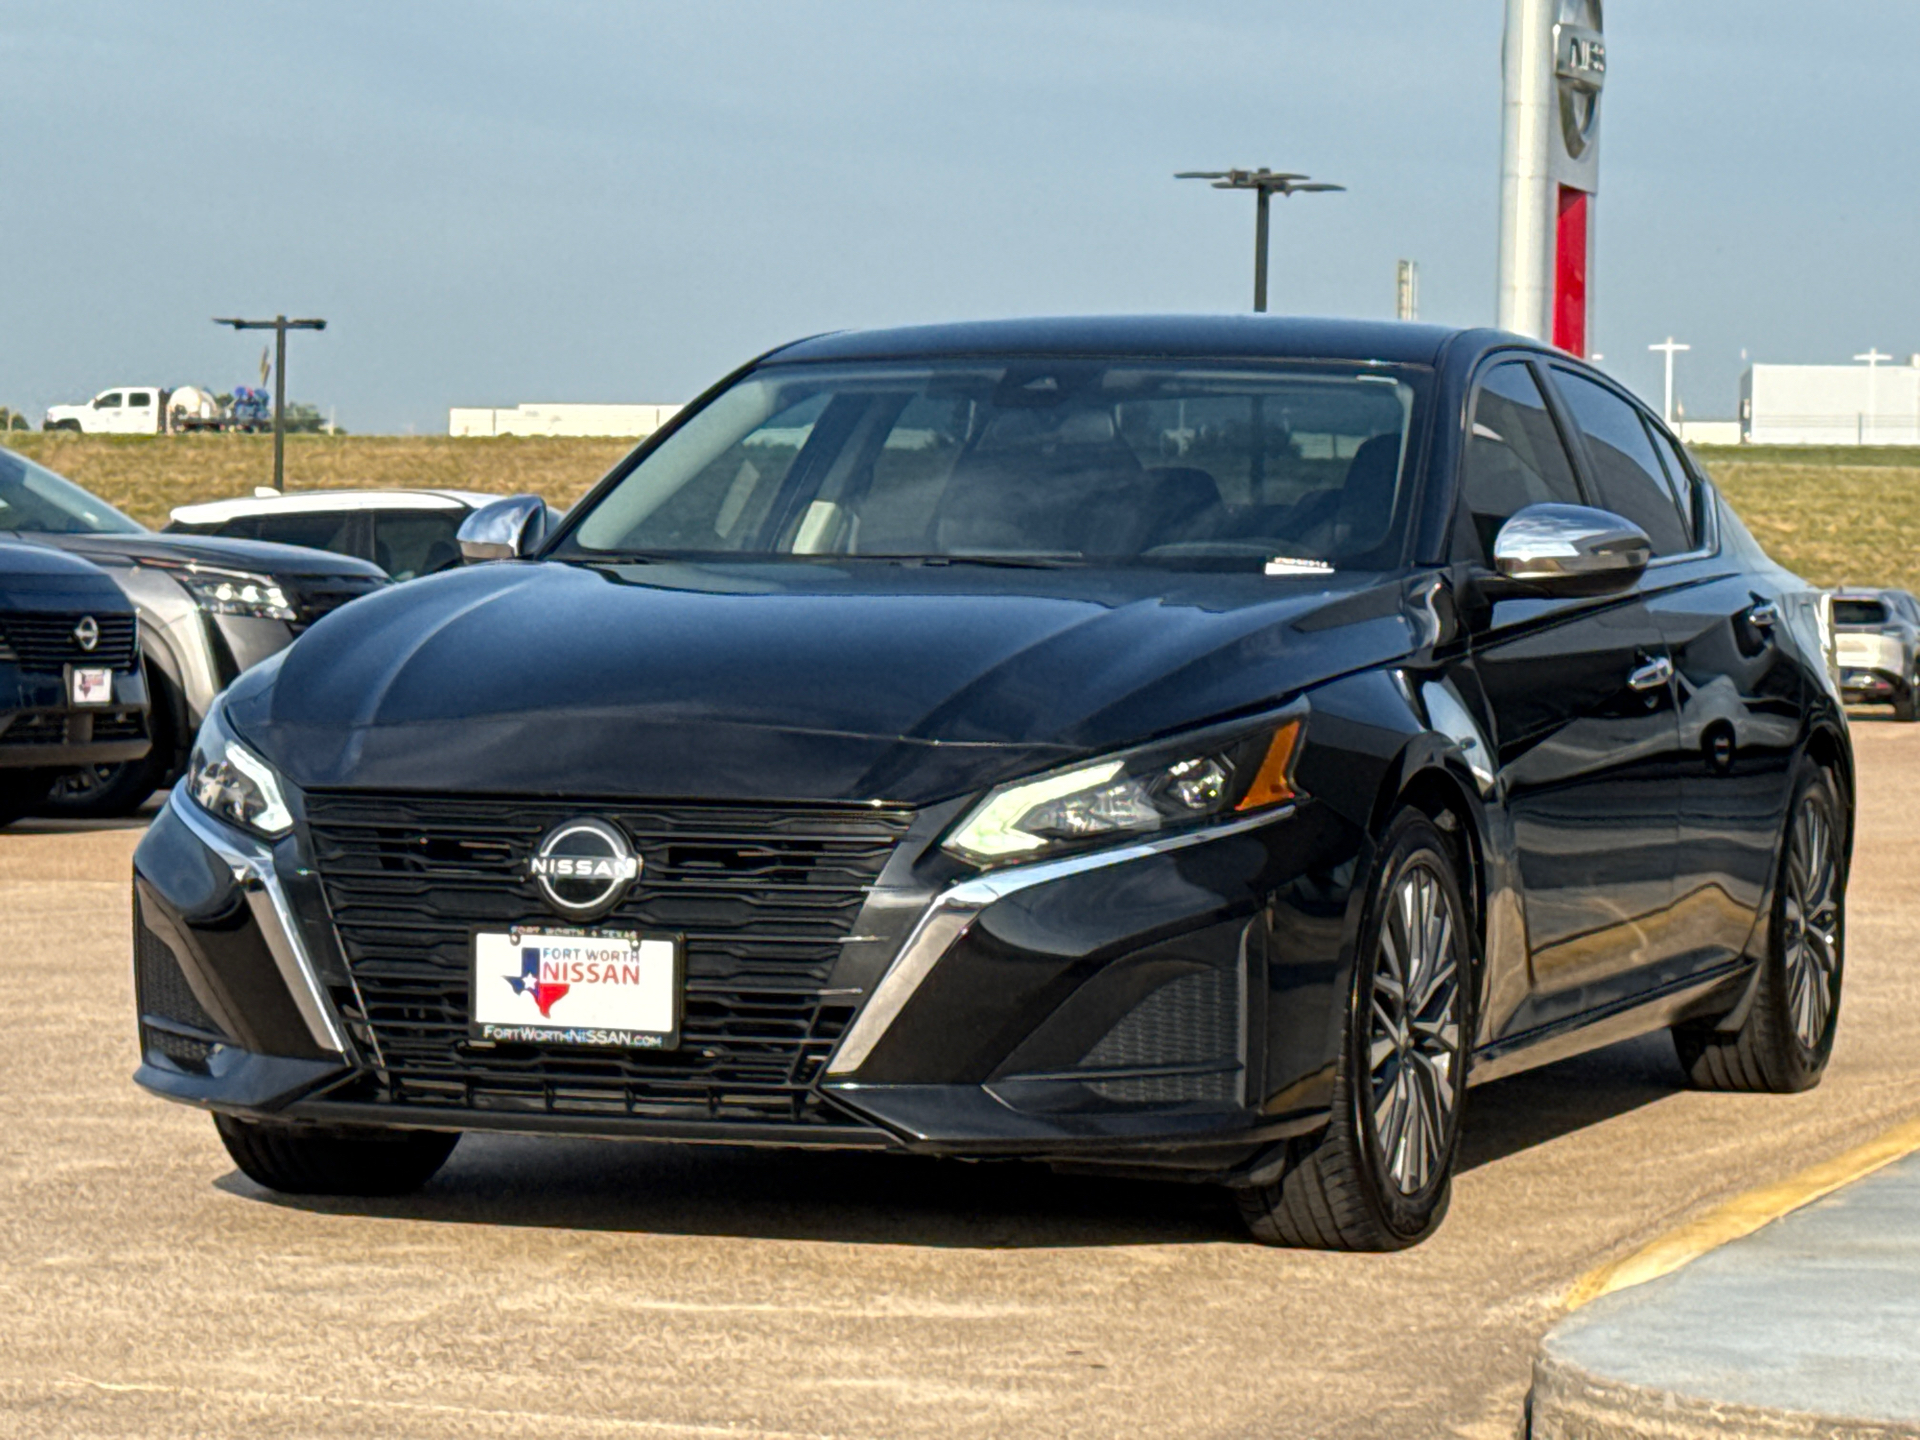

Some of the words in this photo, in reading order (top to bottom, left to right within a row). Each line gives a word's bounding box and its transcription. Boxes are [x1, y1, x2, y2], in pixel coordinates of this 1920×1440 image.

[531, 858, 628, 876] NISSAN
[543, 947, 581, 960] FORT
[585, 949, 640, 963] WORTH
[543, 961, 640, 985] NISSAN
